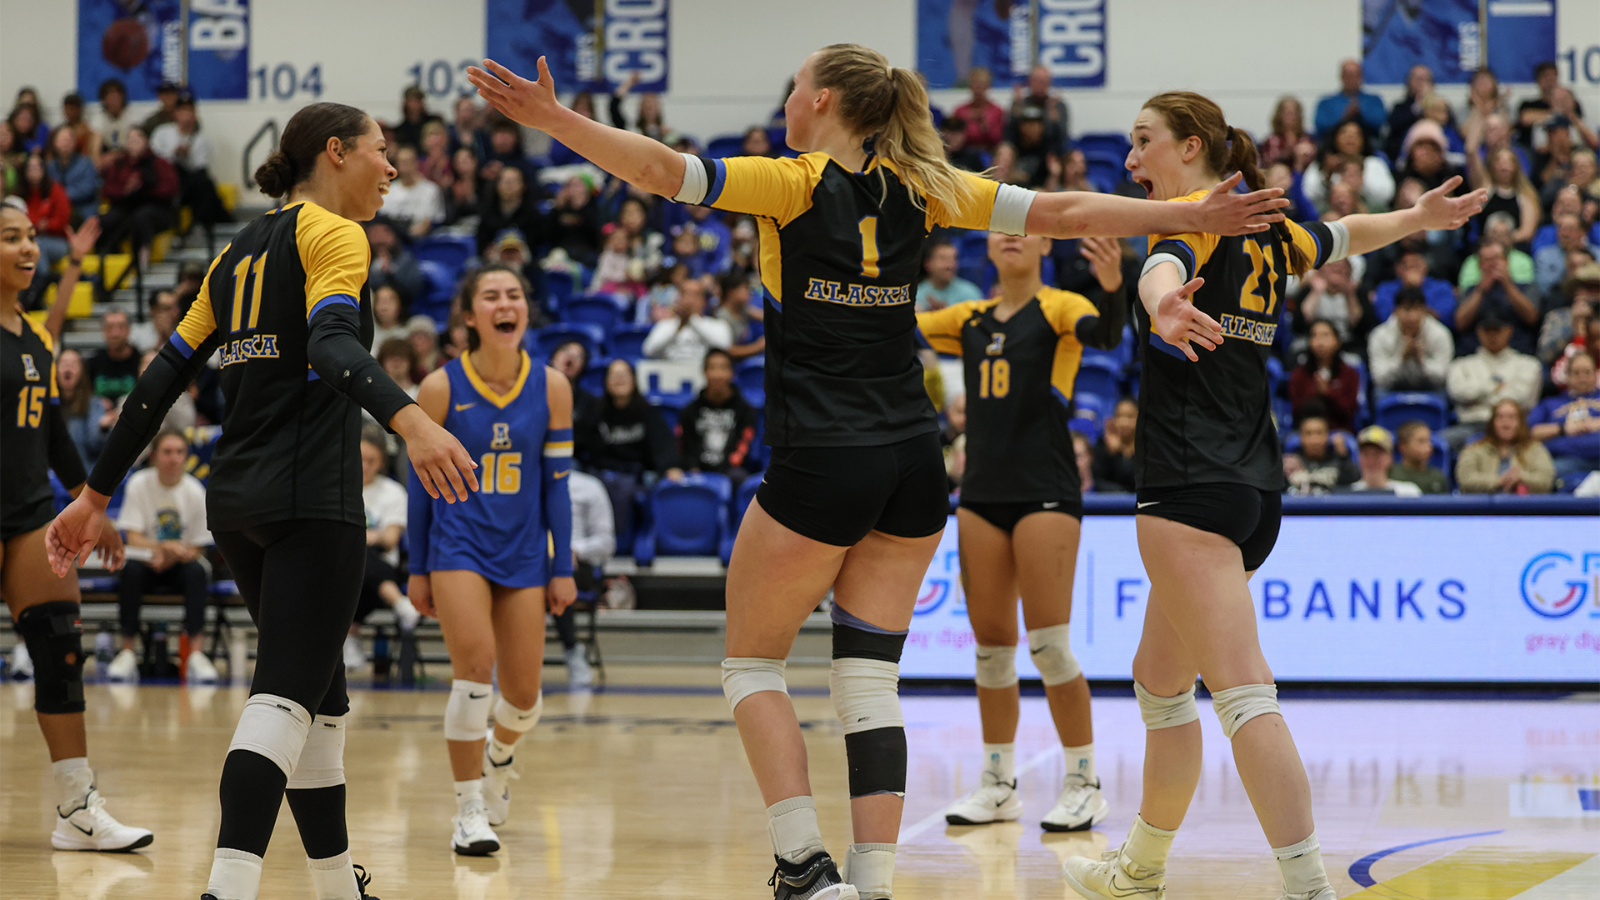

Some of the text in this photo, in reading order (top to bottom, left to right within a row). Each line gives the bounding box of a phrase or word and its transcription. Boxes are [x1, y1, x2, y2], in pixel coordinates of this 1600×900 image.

[252, 62, 324, 99] 104
[858, 214, 881, 279] 1
[230, 249, 269, 334] 11
[804, 277, 911, 307] ALASKA
[1239, 237, 1278, 317] 21
[979, 358, 1011, 399] 18
[17, 385, 47, 428] 15
[480, 451, 522, 495] 16
[1115, 578, 1467, 620] FBANKS
